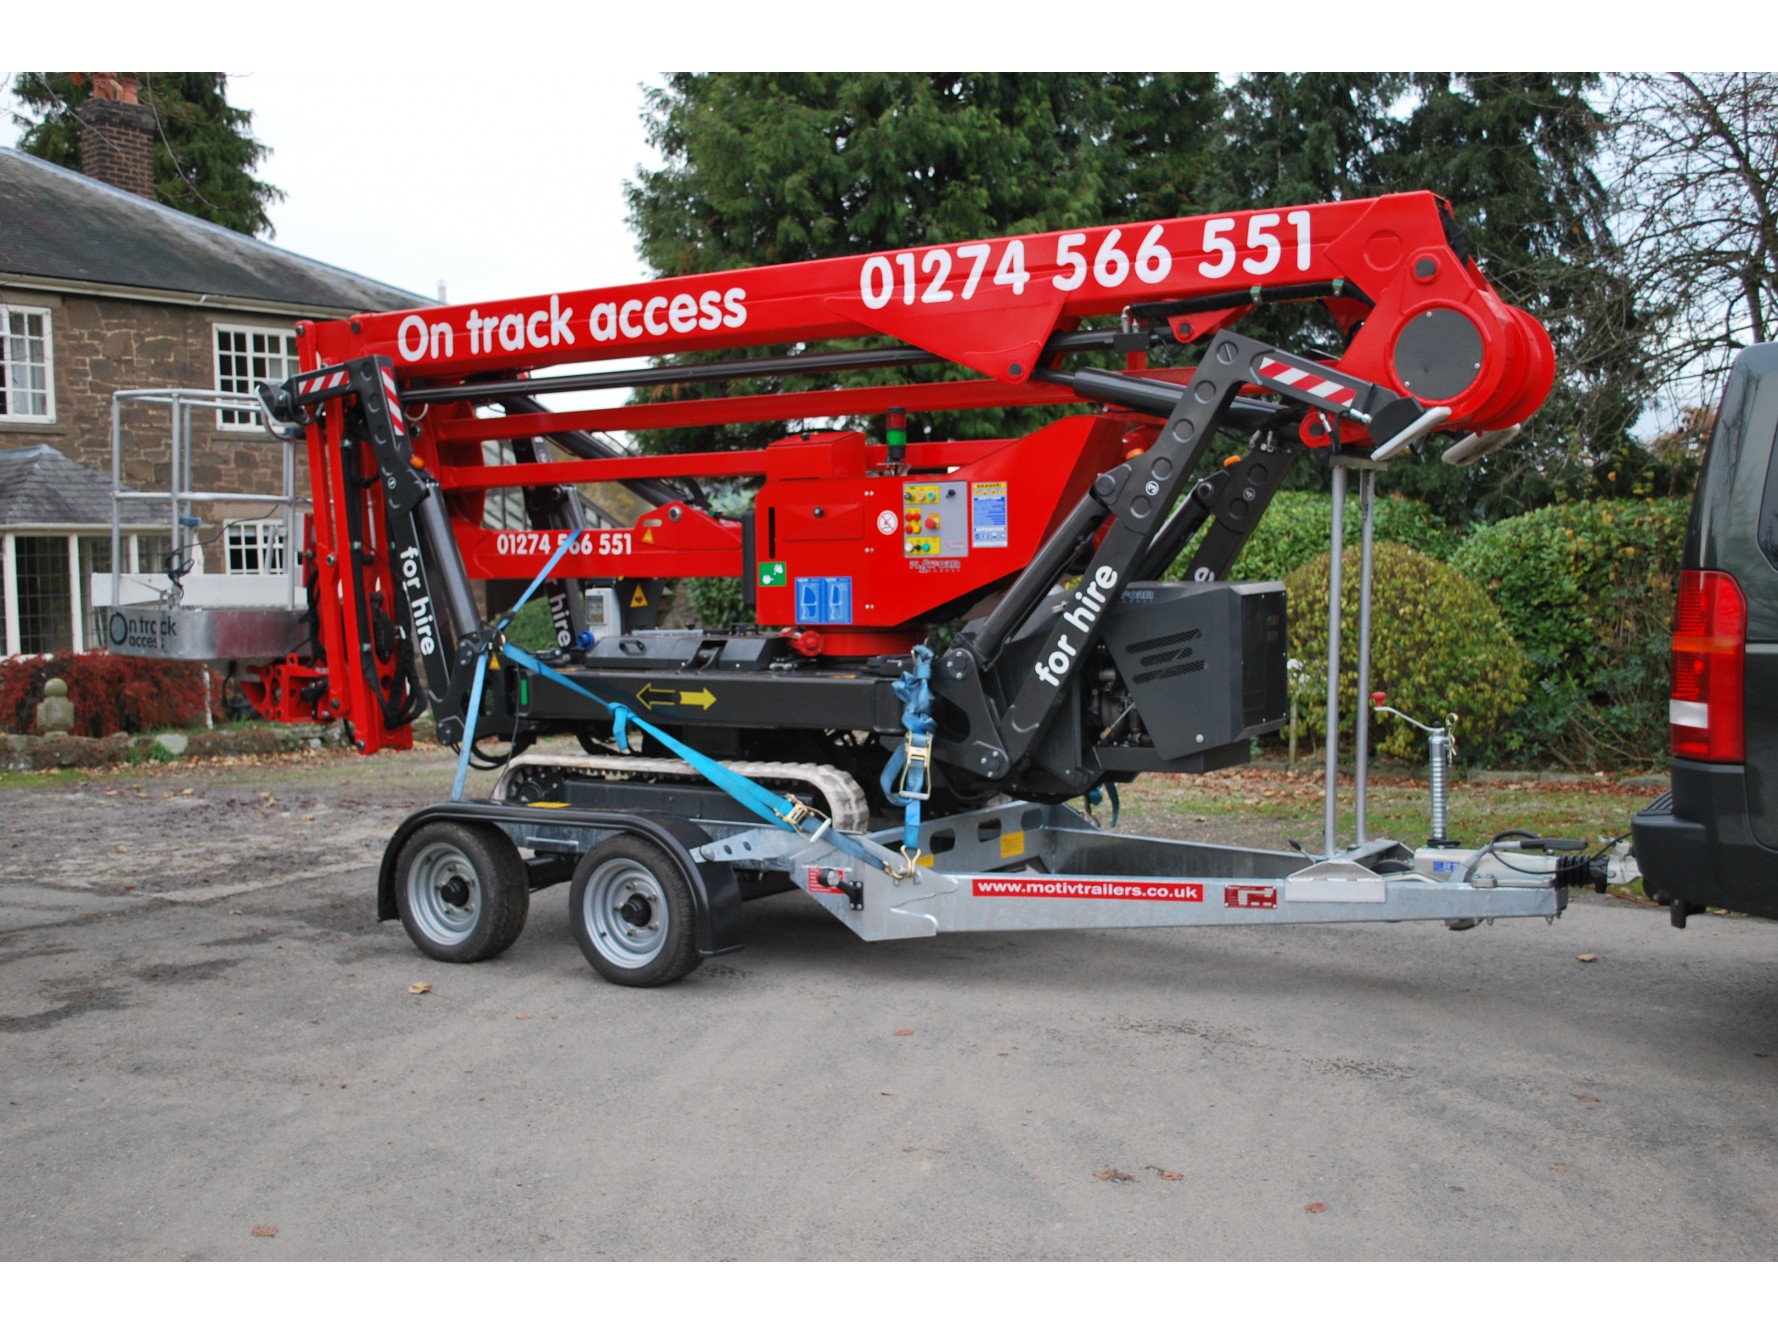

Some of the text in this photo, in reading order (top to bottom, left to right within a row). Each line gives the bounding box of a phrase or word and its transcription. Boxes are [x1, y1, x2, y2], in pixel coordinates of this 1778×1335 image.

[860, 211, 1311, 310] 01274 566 551
[398, 287, 748, 362] On track access
[497, 533, 551, 556] 01274
[598, 533, 632, 556] 551
[109, 612, 137, 645] On
[400, 546, 435, 656] for hire
[549, 592, 572, 648] hire
[1035, 565, 1118, 687] for hire
[977, 880, 1198, 899] www.motivtrailers.co.uk
